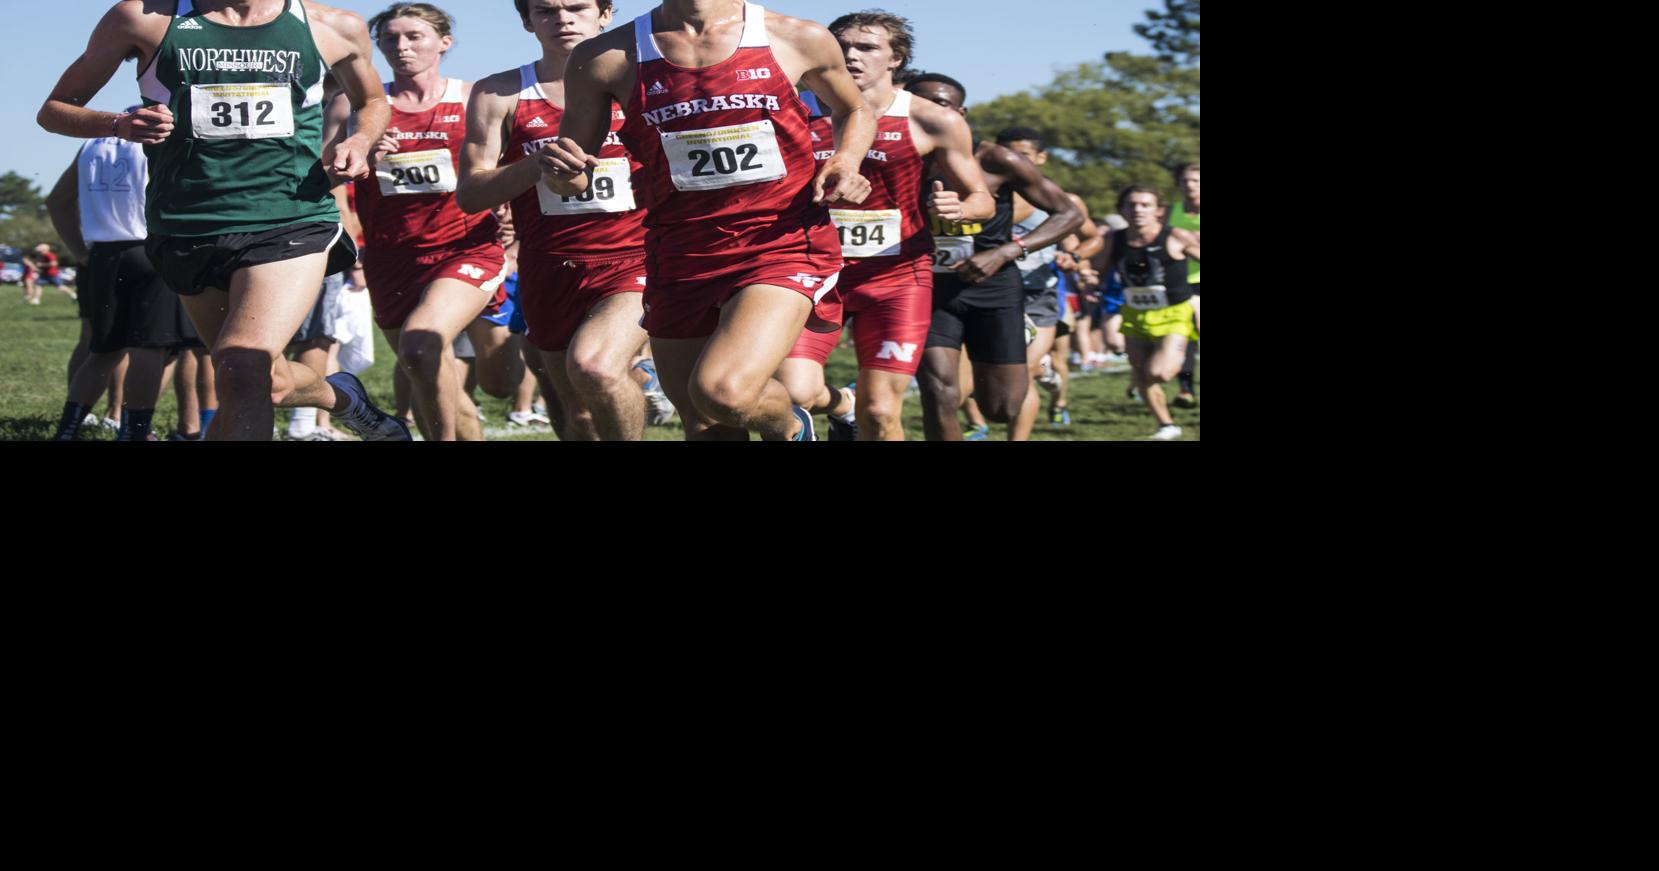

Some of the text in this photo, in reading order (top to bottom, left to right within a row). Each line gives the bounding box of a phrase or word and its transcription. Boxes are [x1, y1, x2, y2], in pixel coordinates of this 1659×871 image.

[178, 48, 300, 74] NORTHWEST
[210, 100, 275, 128] 312
[641, 94, 780, 126] NEBRASKA
[687, 143, 763, 177] 202
[87, 155, 131, 192] 12
[390, 164, 441, 186] 200
[837, 224, 886, 246] 194
[457, 263, 486, 280] N
[874, 341, 918, 363] N
